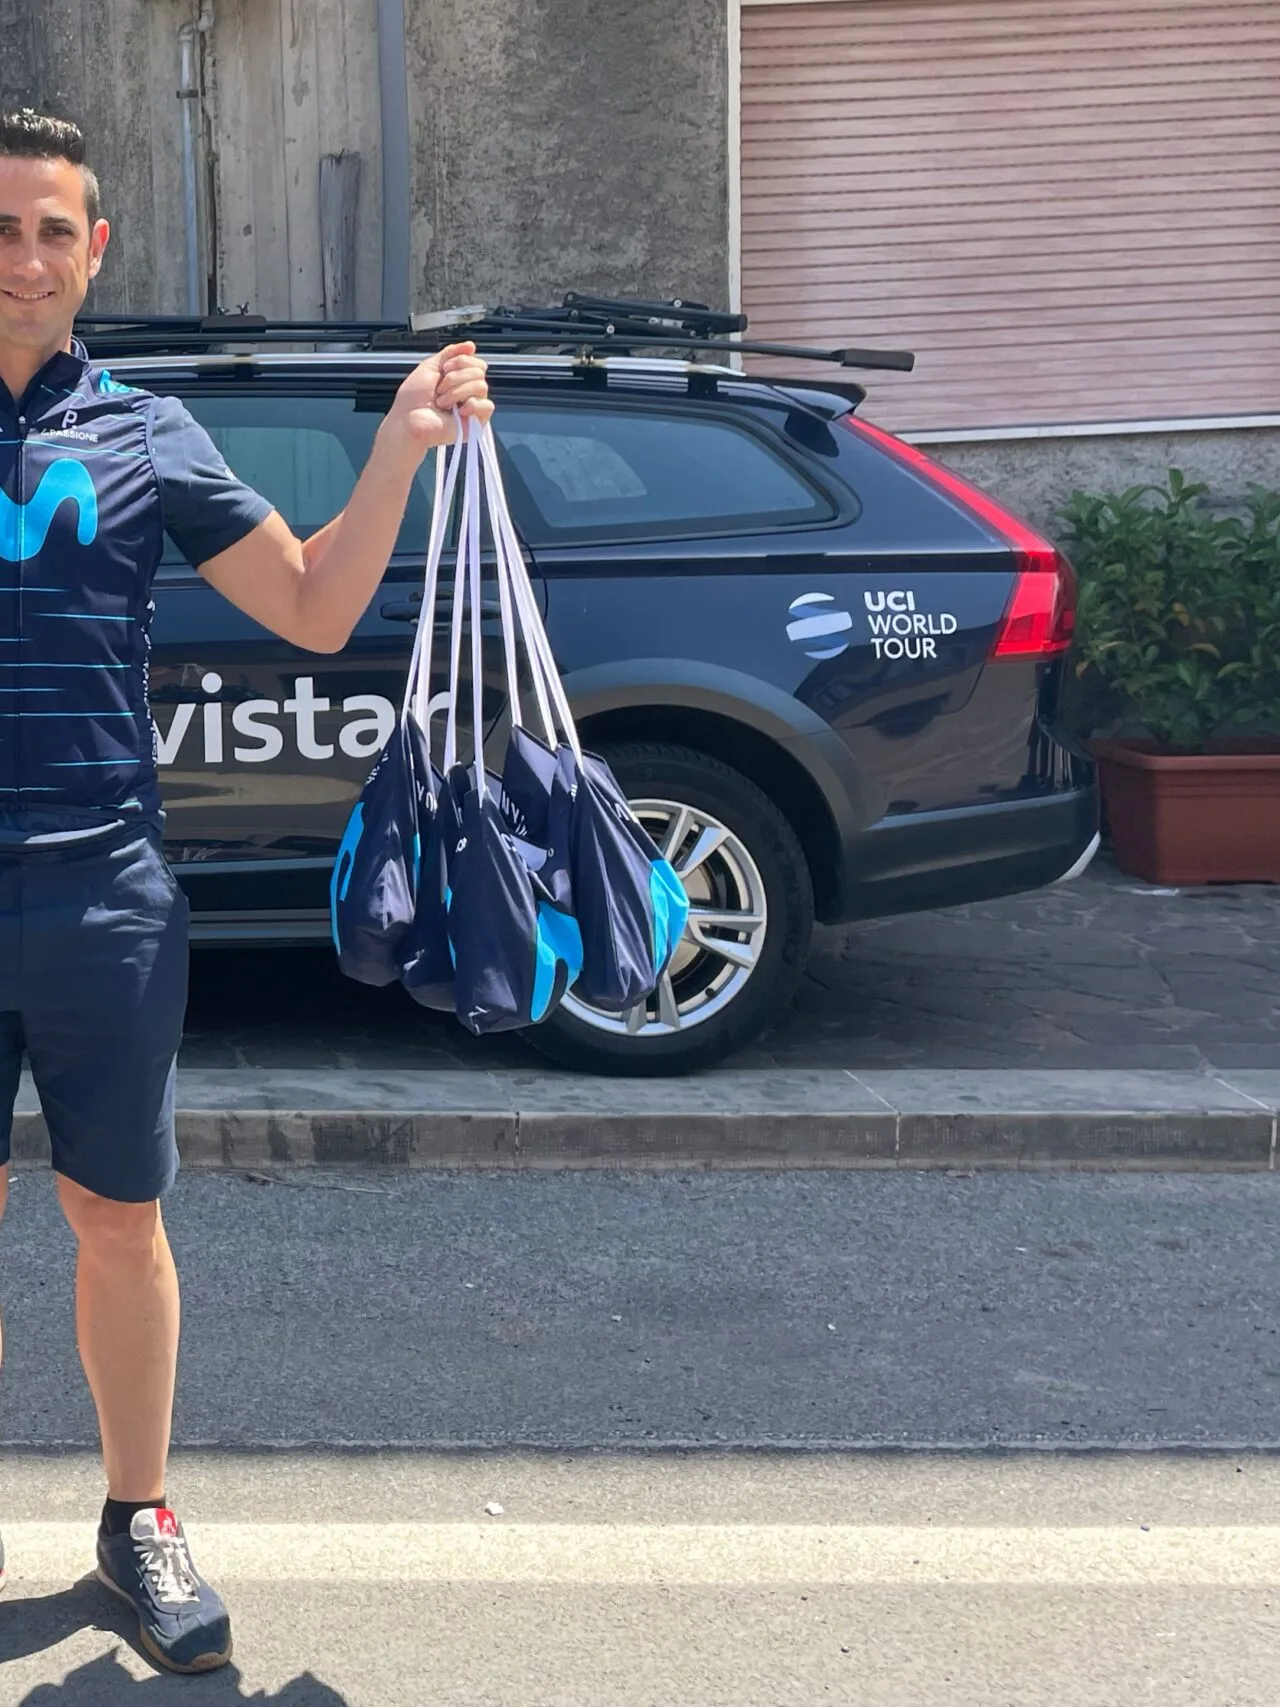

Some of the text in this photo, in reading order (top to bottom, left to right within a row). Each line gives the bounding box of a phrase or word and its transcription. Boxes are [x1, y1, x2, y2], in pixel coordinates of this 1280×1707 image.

[863, 590, 916, 612] UCI
[867, 613, 958, 635] WORLD
[870, 637, 938, 659] TOUR
